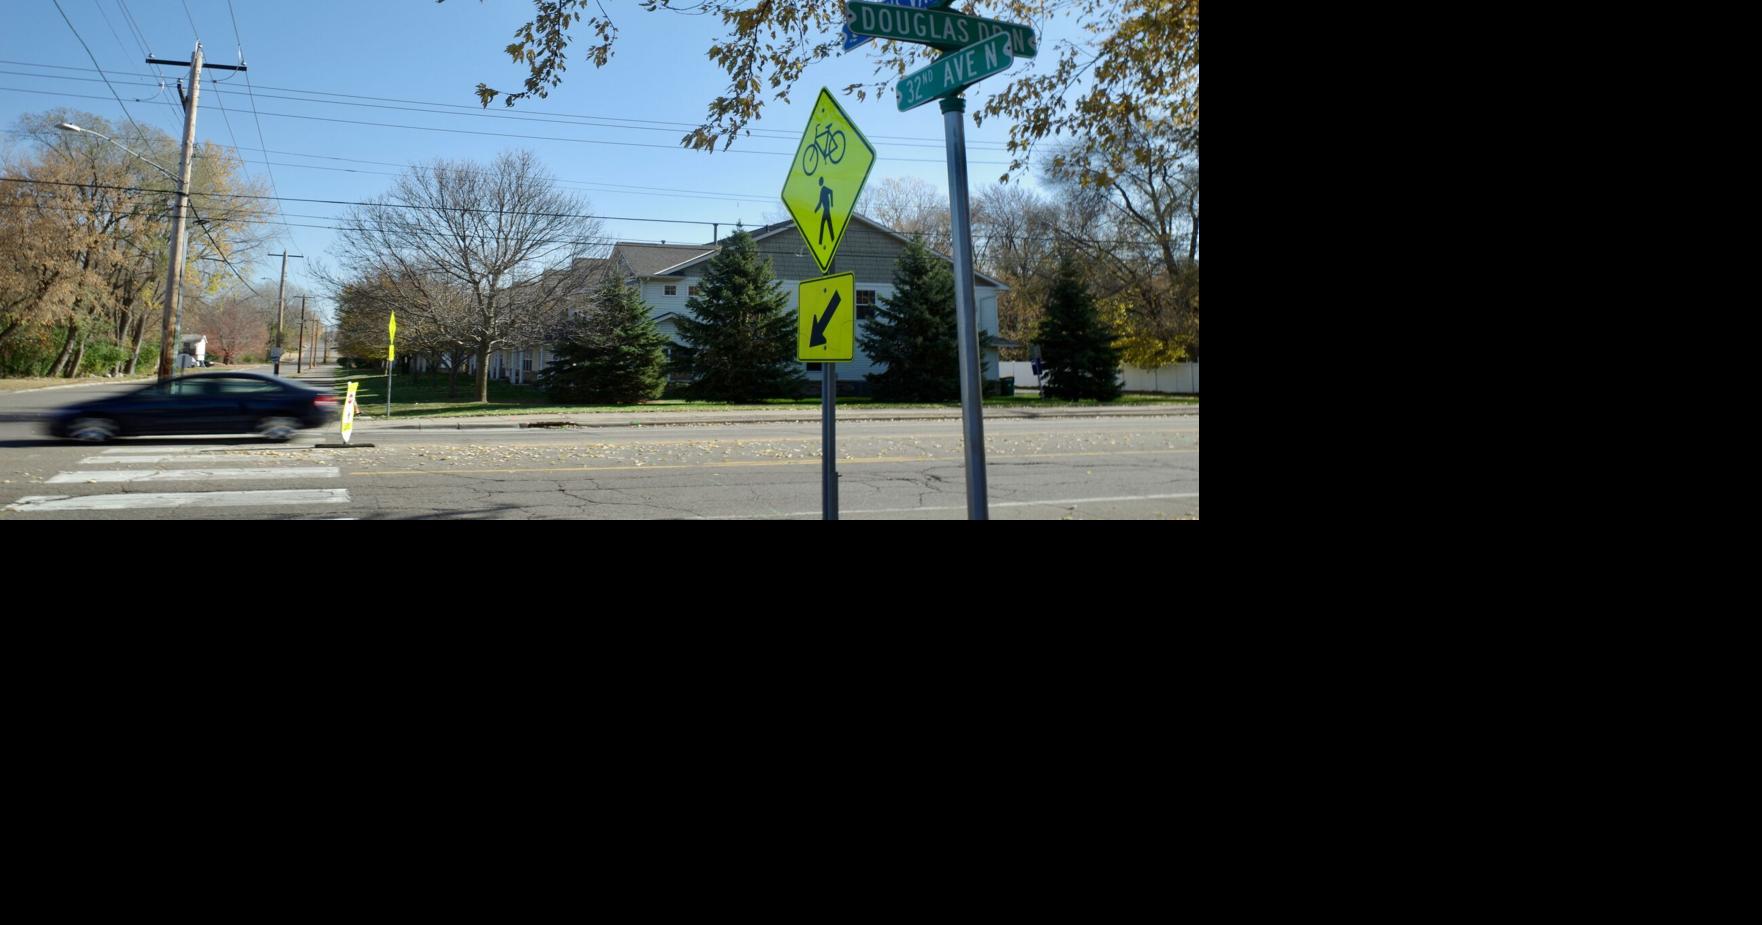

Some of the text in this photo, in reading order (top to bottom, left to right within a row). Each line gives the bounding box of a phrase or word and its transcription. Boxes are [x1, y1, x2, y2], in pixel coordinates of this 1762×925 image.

[861, 6, 970, 43] DOUGLAS
[1012, 28, 1025, 52] N
[906, 41, 998, 103] 32ND AVE N
